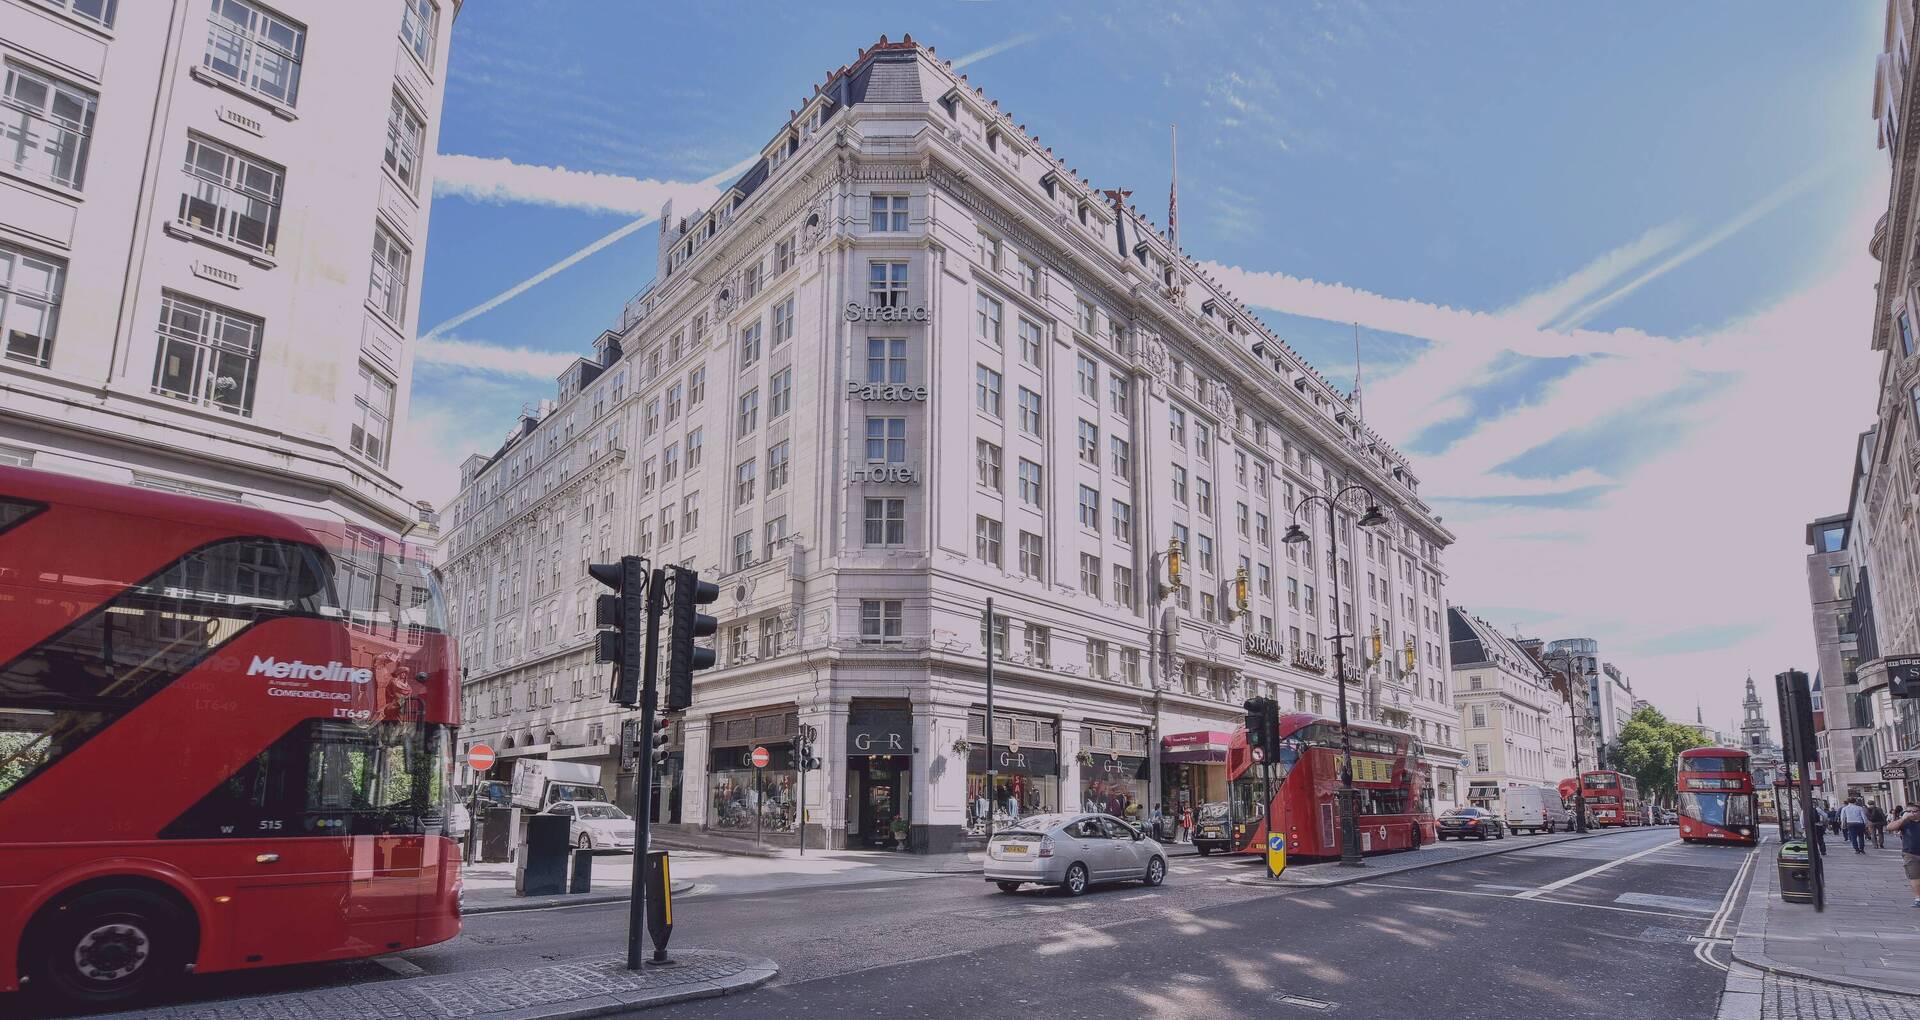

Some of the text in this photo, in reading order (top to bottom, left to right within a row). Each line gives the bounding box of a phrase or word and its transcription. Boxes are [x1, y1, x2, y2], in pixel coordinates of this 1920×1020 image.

[843, 301, 931, 324] Strand
[845, 380, 928, 402] Palace
[851, 461, 920, 484] Hotel
[1247, 632, 1363, 680] STRAND PALACE HOTE
[246, 655, 373, 684] Metroline
[333, 708, 371, 719] LT649
[259, 820, 283, 830] 515
